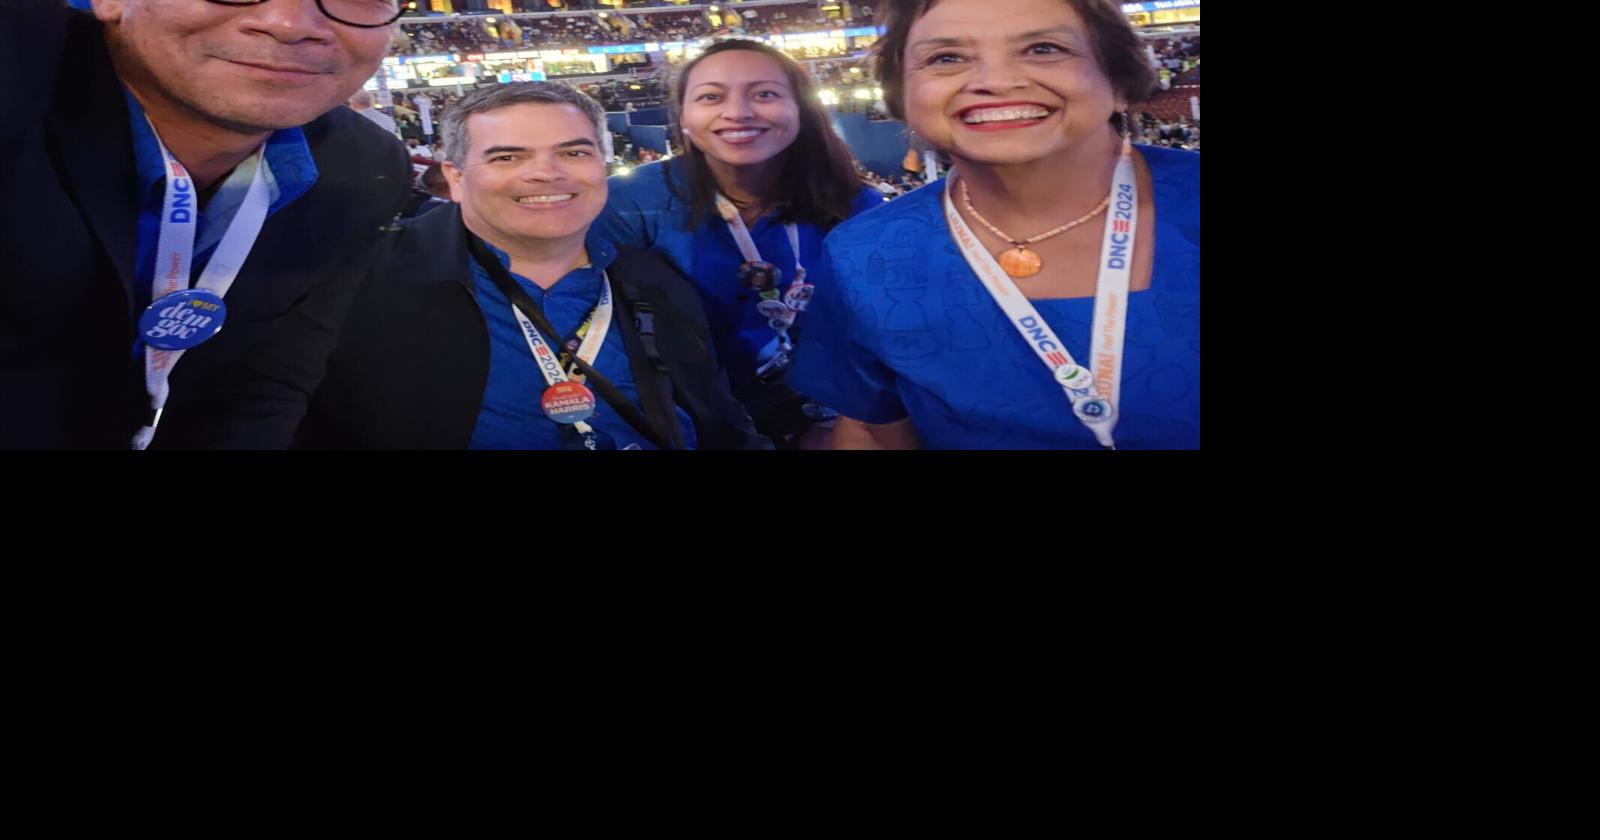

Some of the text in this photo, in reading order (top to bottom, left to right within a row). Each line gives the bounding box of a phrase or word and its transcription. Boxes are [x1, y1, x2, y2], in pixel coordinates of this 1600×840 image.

[170, 178, 191, 224] DNC
[1107, 183, 1133, 270] DNC 2024
[160, 302, 212, 328] dem
[523, 321, 542, 347] DNC
[1019, 316, 1057, 353] DNC
[544, 396, 591, 409] KAMALA
[550, 403, 590, 415] HARRIS
